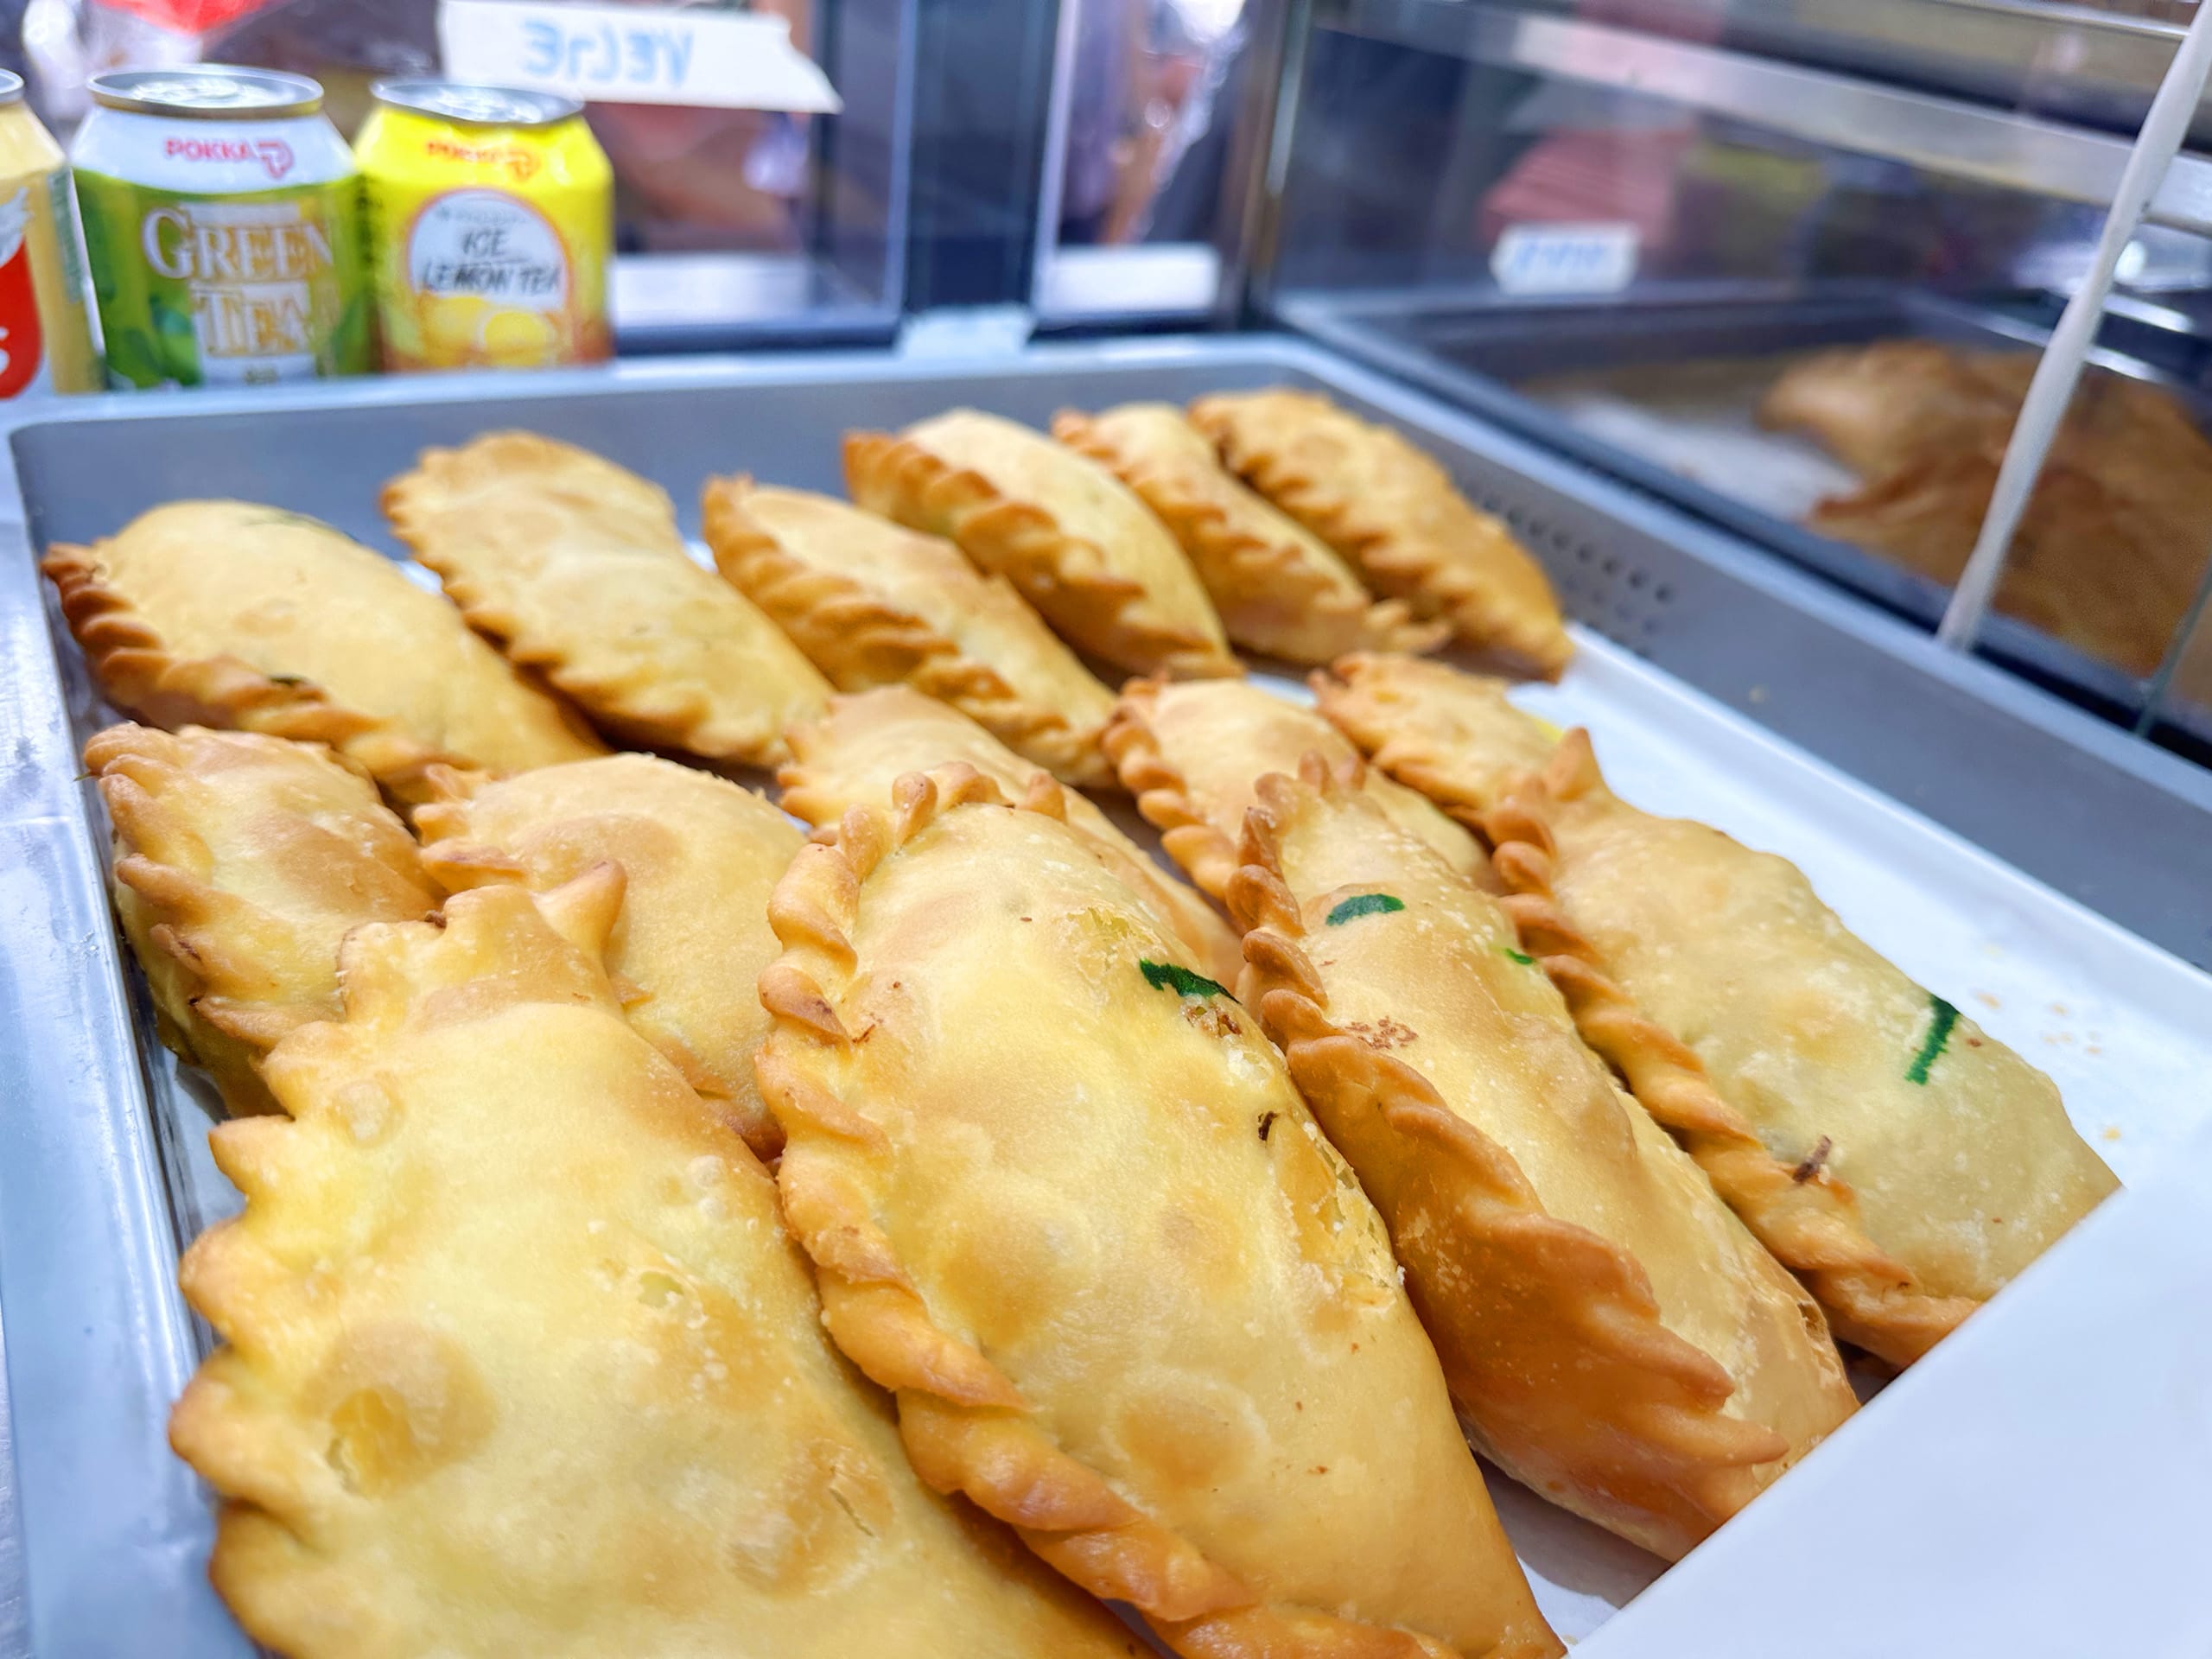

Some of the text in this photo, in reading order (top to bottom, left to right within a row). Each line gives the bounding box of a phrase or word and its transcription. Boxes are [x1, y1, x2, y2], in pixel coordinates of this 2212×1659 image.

[164, 137, 257, 162] POKKA
[142, 207, 334, 279] GREEN
[462, 227, 508, 257] ICE
[422, 258, 562, 294] LEMON TEA
[190, 288, 314, 357] TEA
